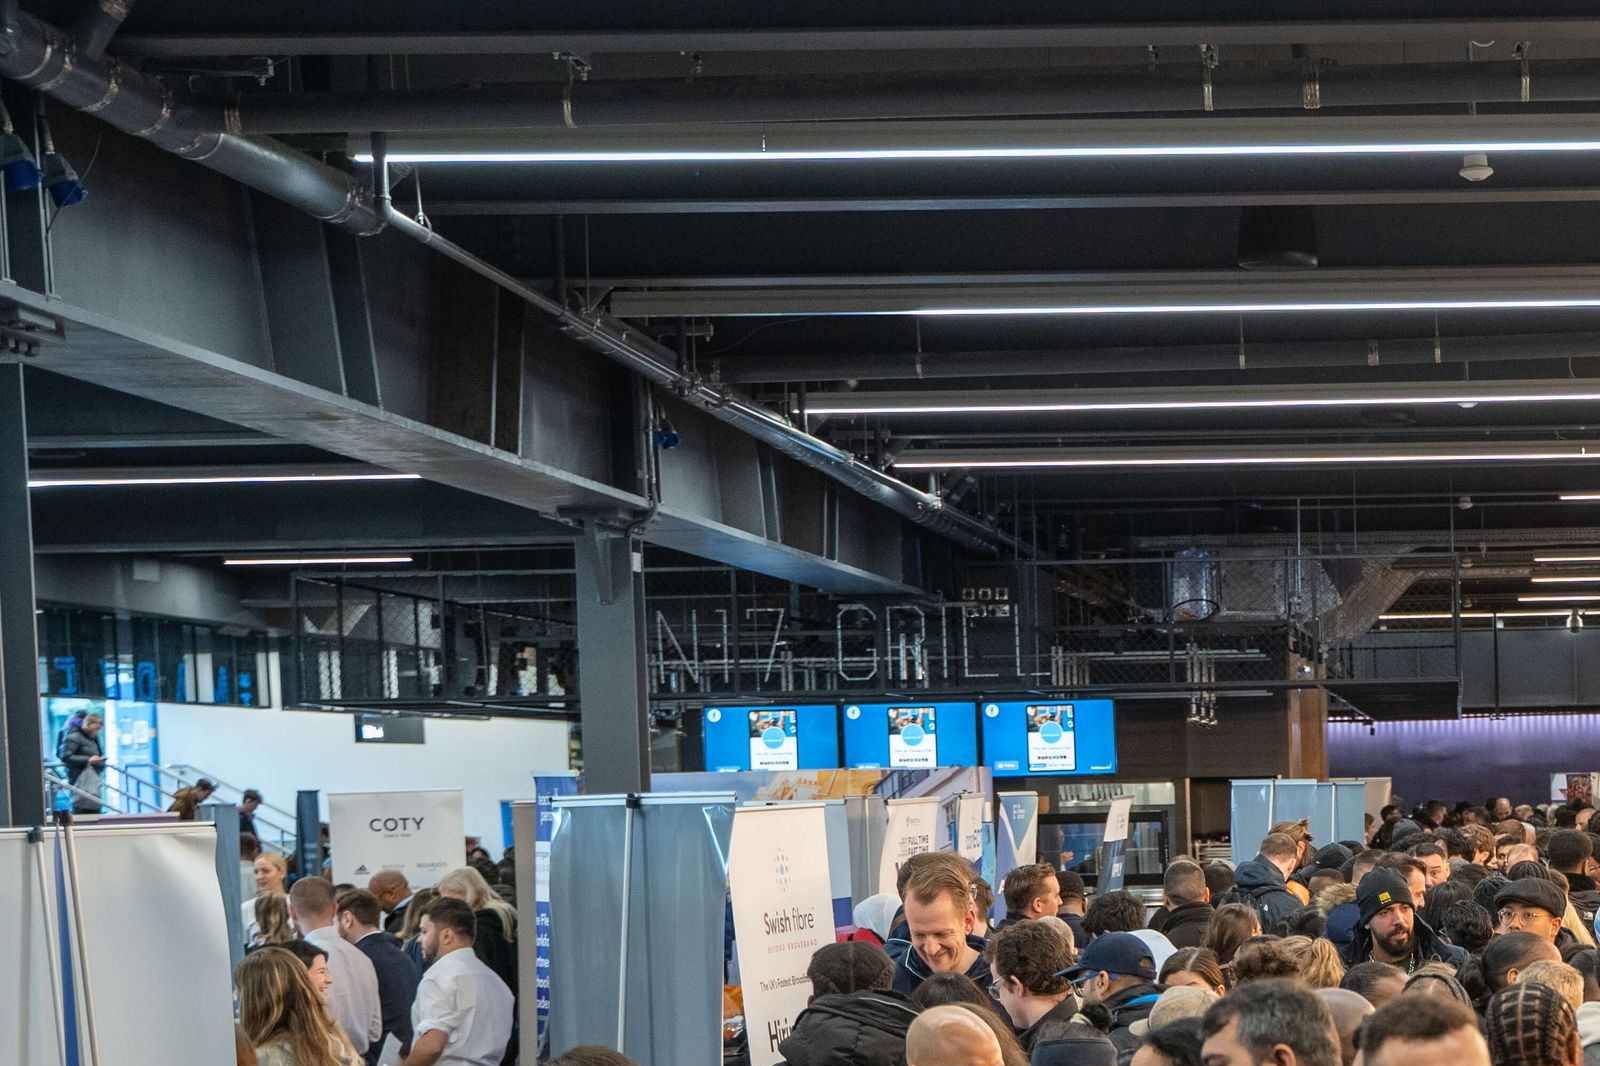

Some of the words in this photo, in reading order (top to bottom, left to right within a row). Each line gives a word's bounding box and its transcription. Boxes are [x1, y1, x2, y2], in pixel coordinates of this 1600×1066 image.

[837, 603, 1050, 681] GRILL
[369, 817, 424, 832] COTY
[764, 908, 791, 935] Swish
[792, 907, 814, 931] fibre
